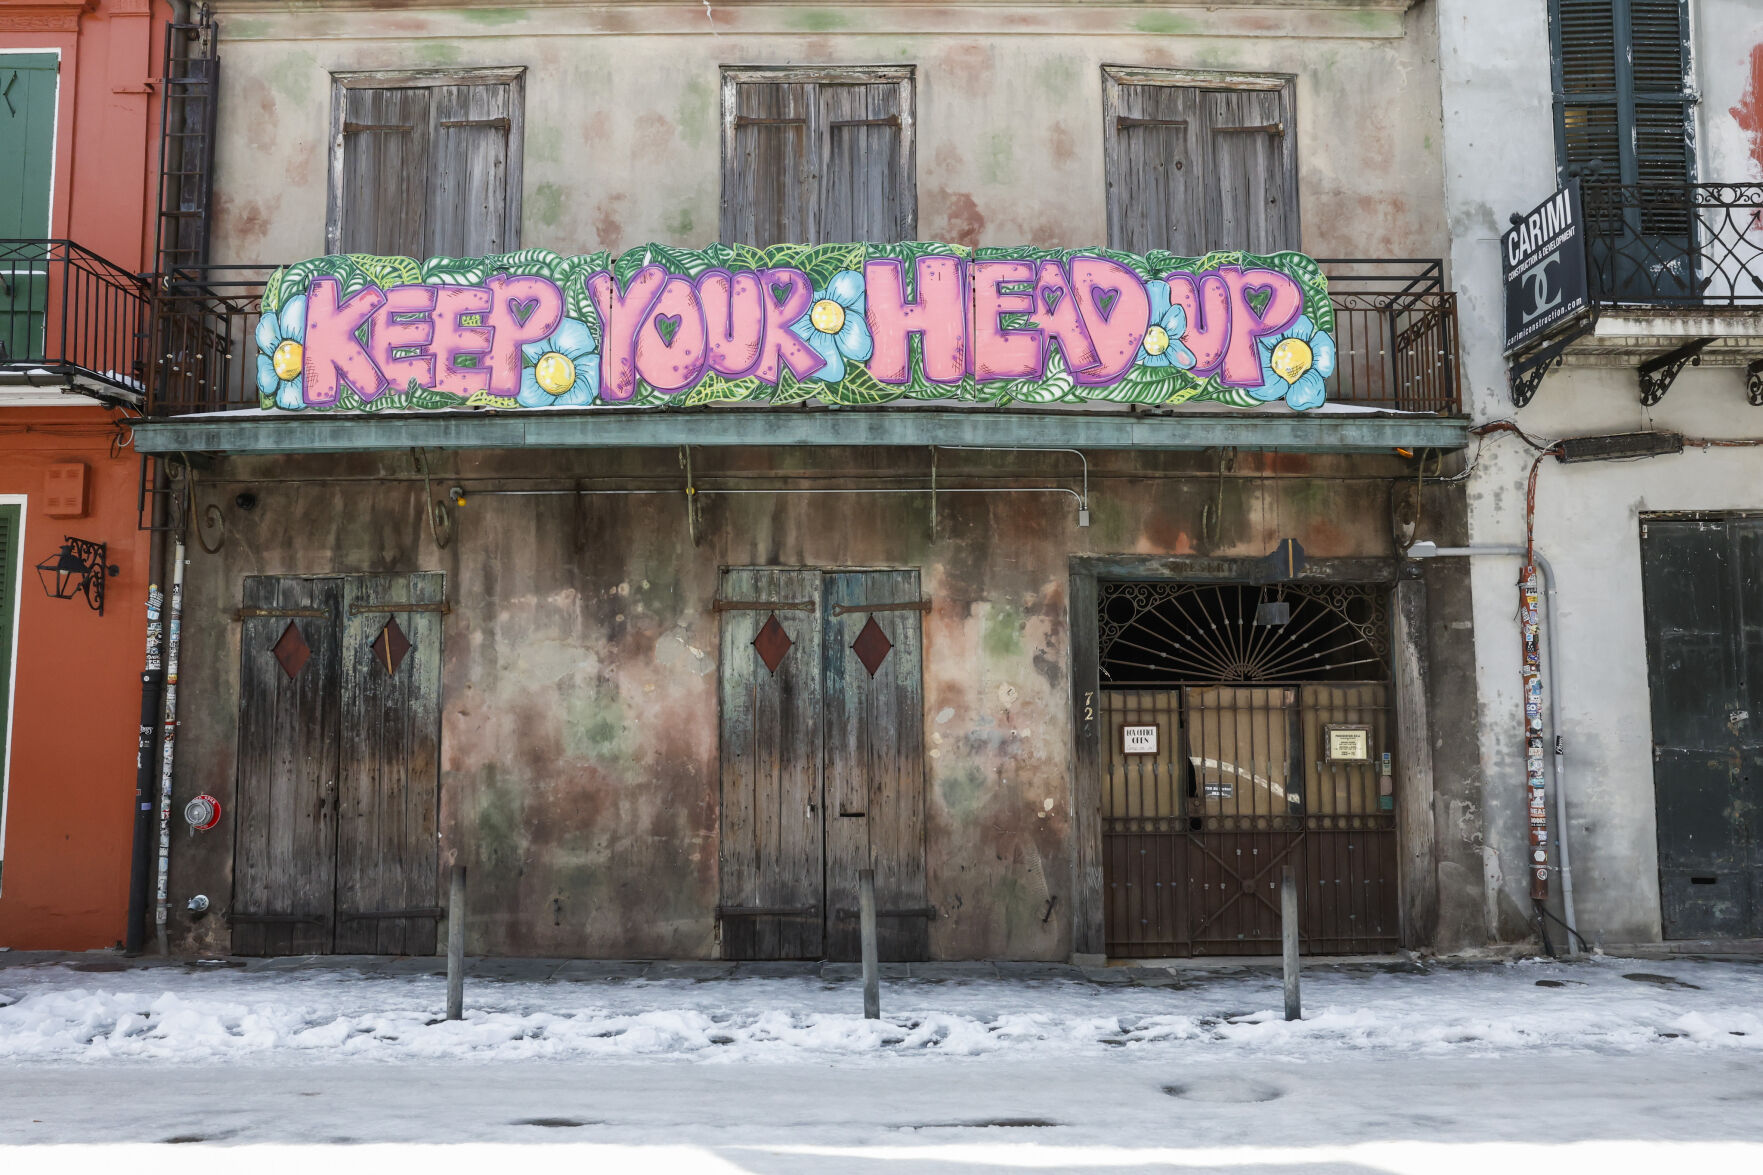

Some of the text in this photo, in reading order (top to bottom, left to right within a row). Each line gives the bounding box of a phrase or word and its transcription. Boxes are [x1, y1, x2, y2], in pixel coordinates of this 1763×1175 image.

[1508, 188, 1572, 266] CARIMI
[1508, 225, 1576, 282] CONSTRUCTION & DEVELOPMENT
[303, 255, 1304, 404] KEEP YOUR HEAD UP
[1507, 297, 1582, 347] carimiconstruction.com
